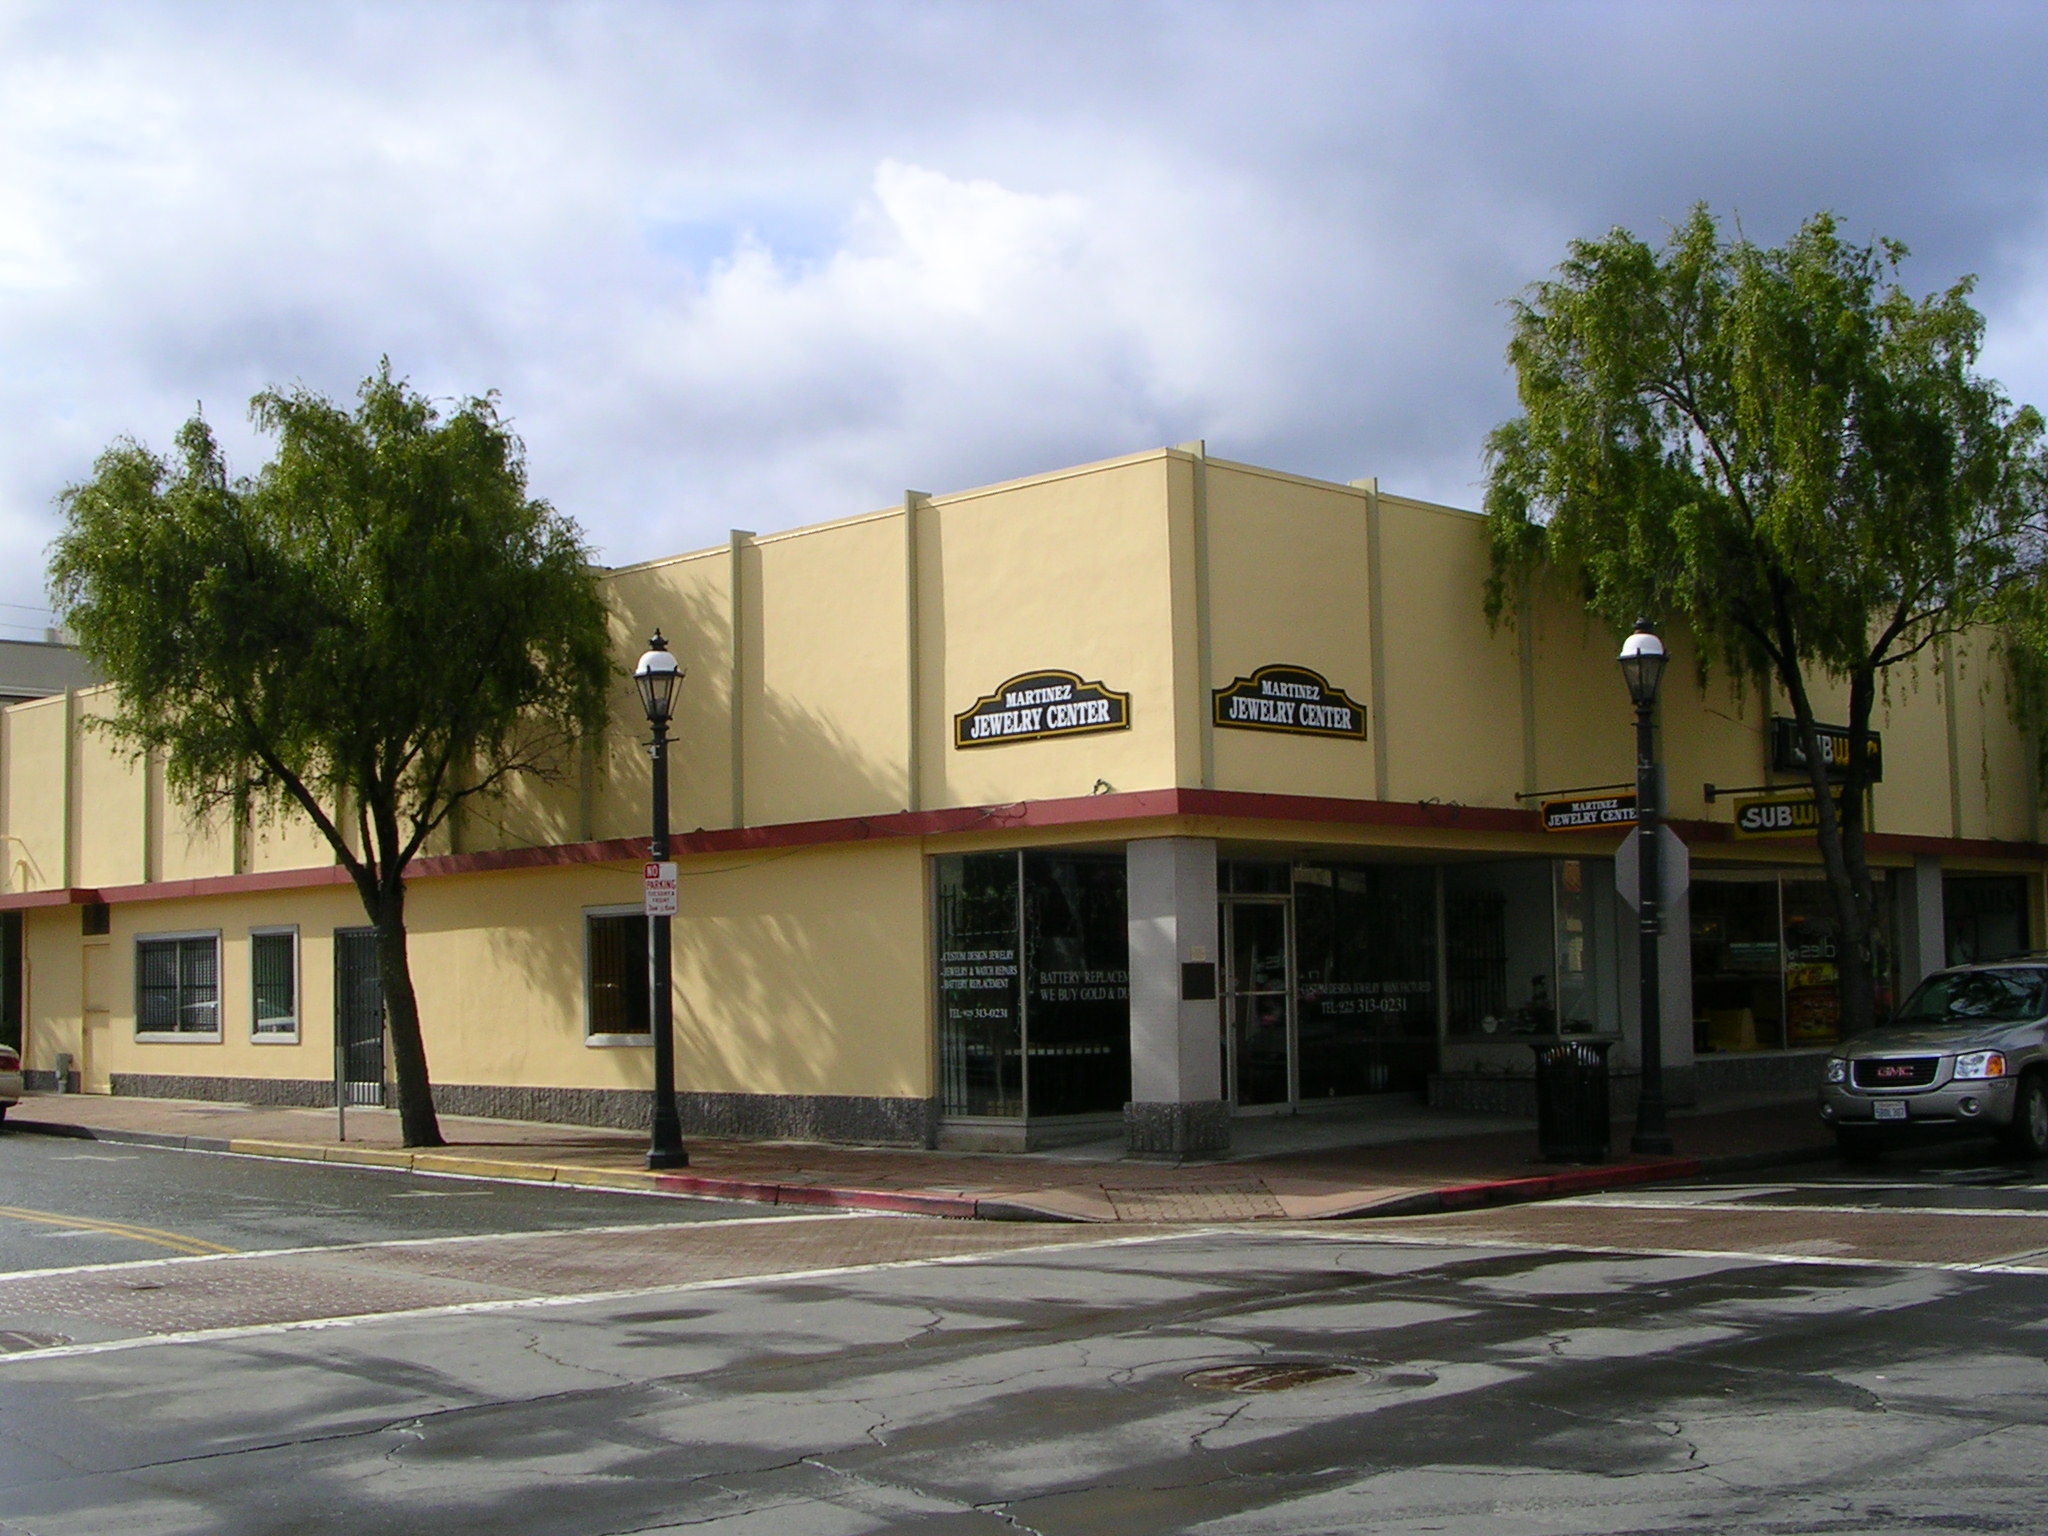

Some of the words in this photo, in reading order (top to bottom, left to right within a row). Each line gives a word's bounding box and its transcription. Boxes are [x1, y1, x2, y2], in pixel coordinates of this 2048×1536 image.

[1005, 685, 1073, 708] MARTINEZ
[1261, 680, 1320, 700] MARTINEZ
[970, 708, 1043, 738] JEWELRY
[1046, 699, 1111, 729] CENTER
[1229, 696, 1296, 724] JEWELRY
[1300, 703, 1352, 729] CENTER
[1571, 799, 1618, 812] MARTINEZ
[1548, 811, 1598, 827] JEWELRY
[1600, 808, 1638, 823] CENTE
[1740, 804, 1842, 829] SUBW
[646, 865, 658, 877] NO
[647, 880, 676, 889] PARKING
[1040, 971, 1080, 985] BATTERY
[1040, 989, 1056, 1002] WE
[1058, 988, 1078, 1001] BUY
[1080, 987, 1106, 1001] GOLD
[1108, 988, 1115, 1000] &
[1356, 998, 1407, 1013] 313-0231
[1878, 1066, 1914, 1078] GMC
